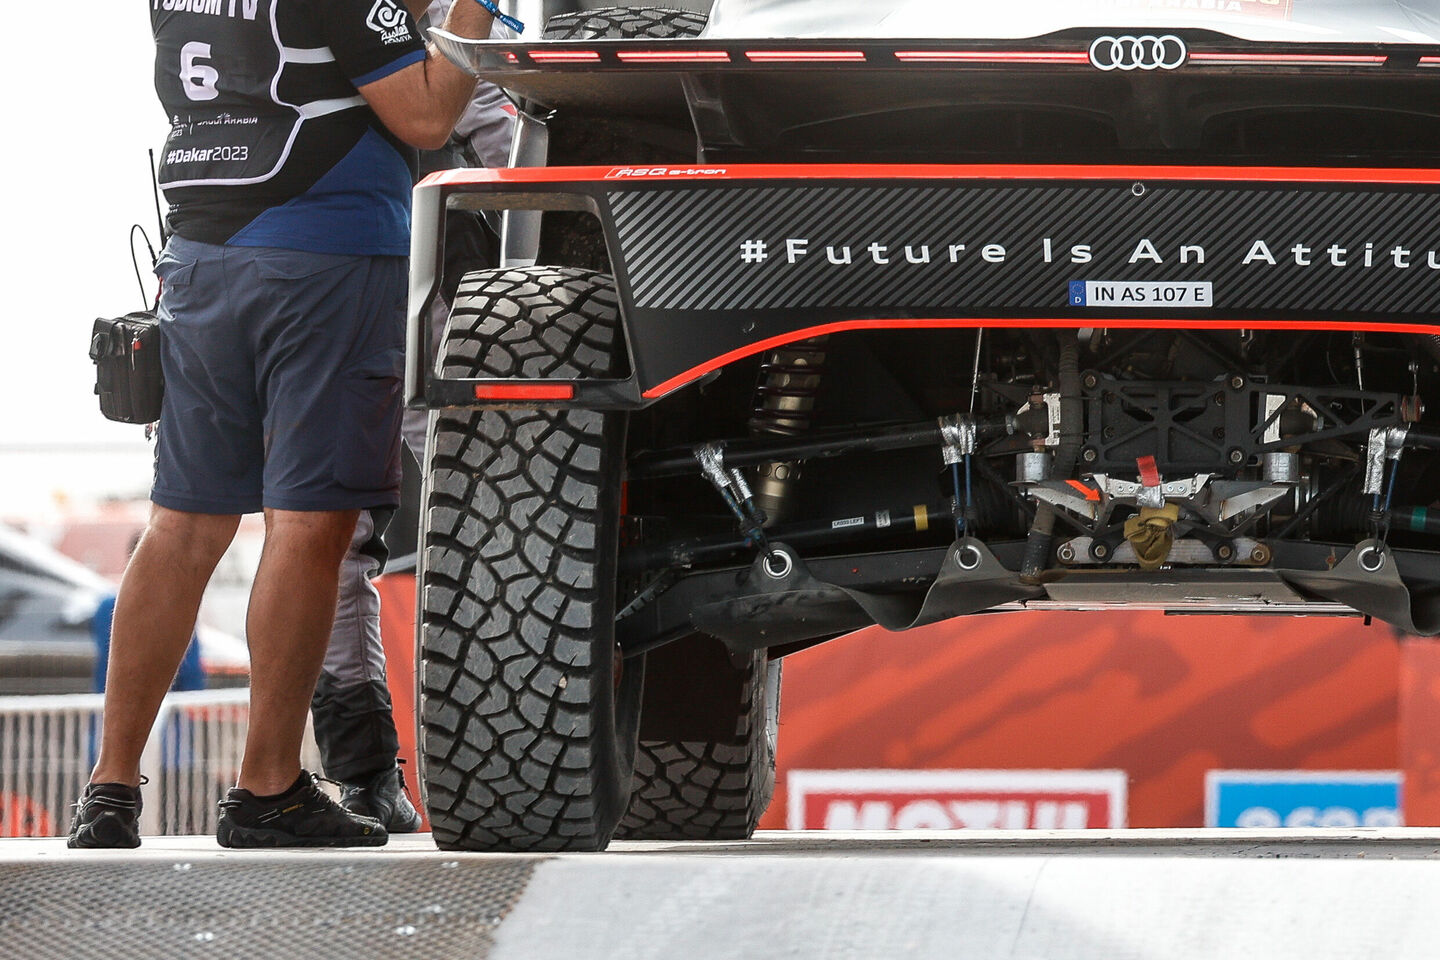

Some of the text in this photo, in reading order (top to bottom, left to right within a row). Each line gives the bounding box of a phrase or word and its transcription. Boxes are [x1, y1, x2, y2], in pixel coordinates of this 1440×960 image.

[179, 40, 219, 101] 6
[166, 146, 249, 165] #Dakar2023
[668, 168, 727, 176] e-tron
[739, 237, 1007, 265] #Future
[1042, 237, 1093, 264] Is
[1128, 238, 1206, 264] An
[1094, 285, 1205, 302] IN AS 107 E
